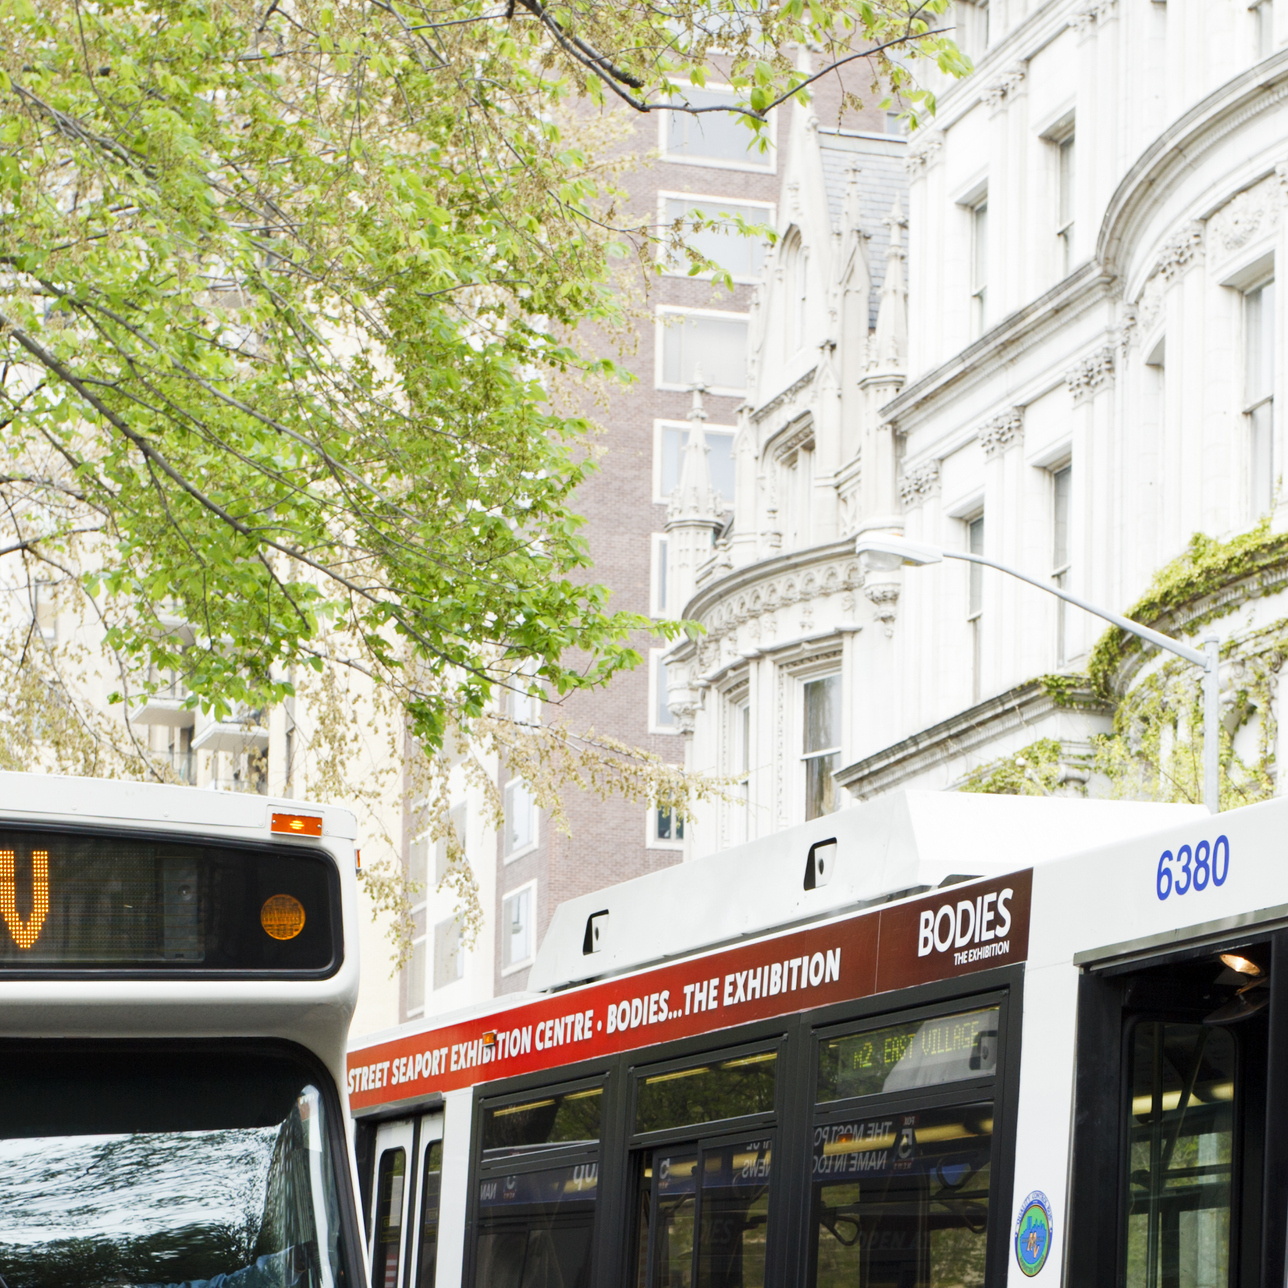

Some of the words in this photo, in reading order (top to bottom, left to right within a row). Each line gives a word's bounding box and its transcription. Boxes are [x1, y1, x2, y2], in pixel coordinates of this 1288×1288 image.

[1156, 835, 1230, 901] 6380
[918, 887, 1014, 958] BODIES
[954, 951, 968, 966] THE
[968, 939, 1010, 963] EXHIBITION
[347, 1060, 391, 1095] STREET
[391, 1047, 449, 1086] SEAPORT
[450, 1025, 533, 1072] EXHIBITION
[534, 1009, 594, 1051] CENTRE
[722, 947, 842, 1007] EXHIBITION
[853, 1041, 873, 1070] M2
[883, 1033, 916, 1064] EAST
[921, 1020, 980, 1056] VILLAGE
